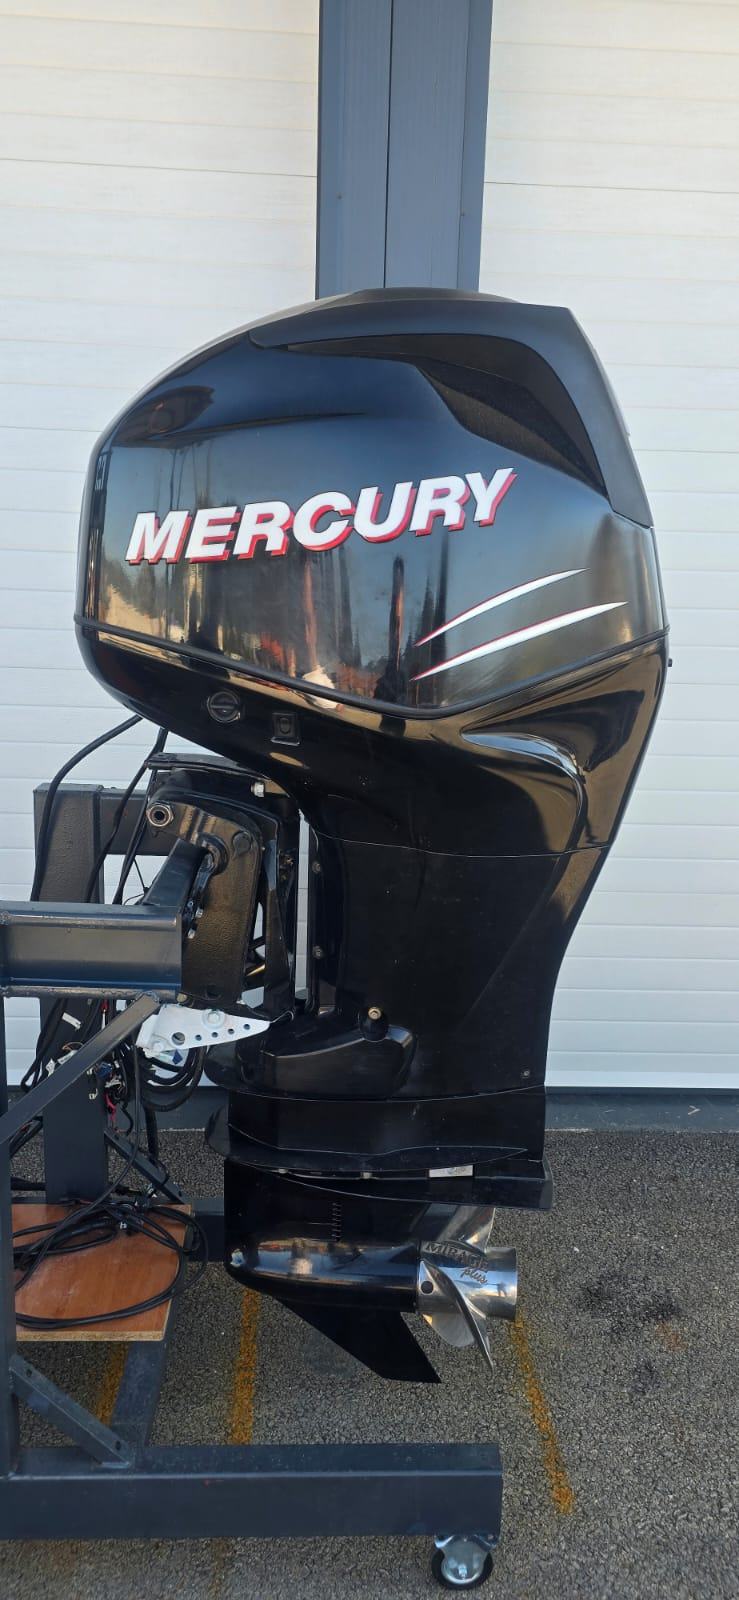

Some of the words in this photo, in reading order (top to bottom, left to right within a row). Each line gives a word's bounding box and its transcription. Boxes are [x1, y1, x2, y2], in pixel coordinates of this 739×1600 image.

[125, 467, 518, 565] MERCURY
[424, 1241, 489, 1271] MIRAGE
[460, 1267, 488, 1284] plus
